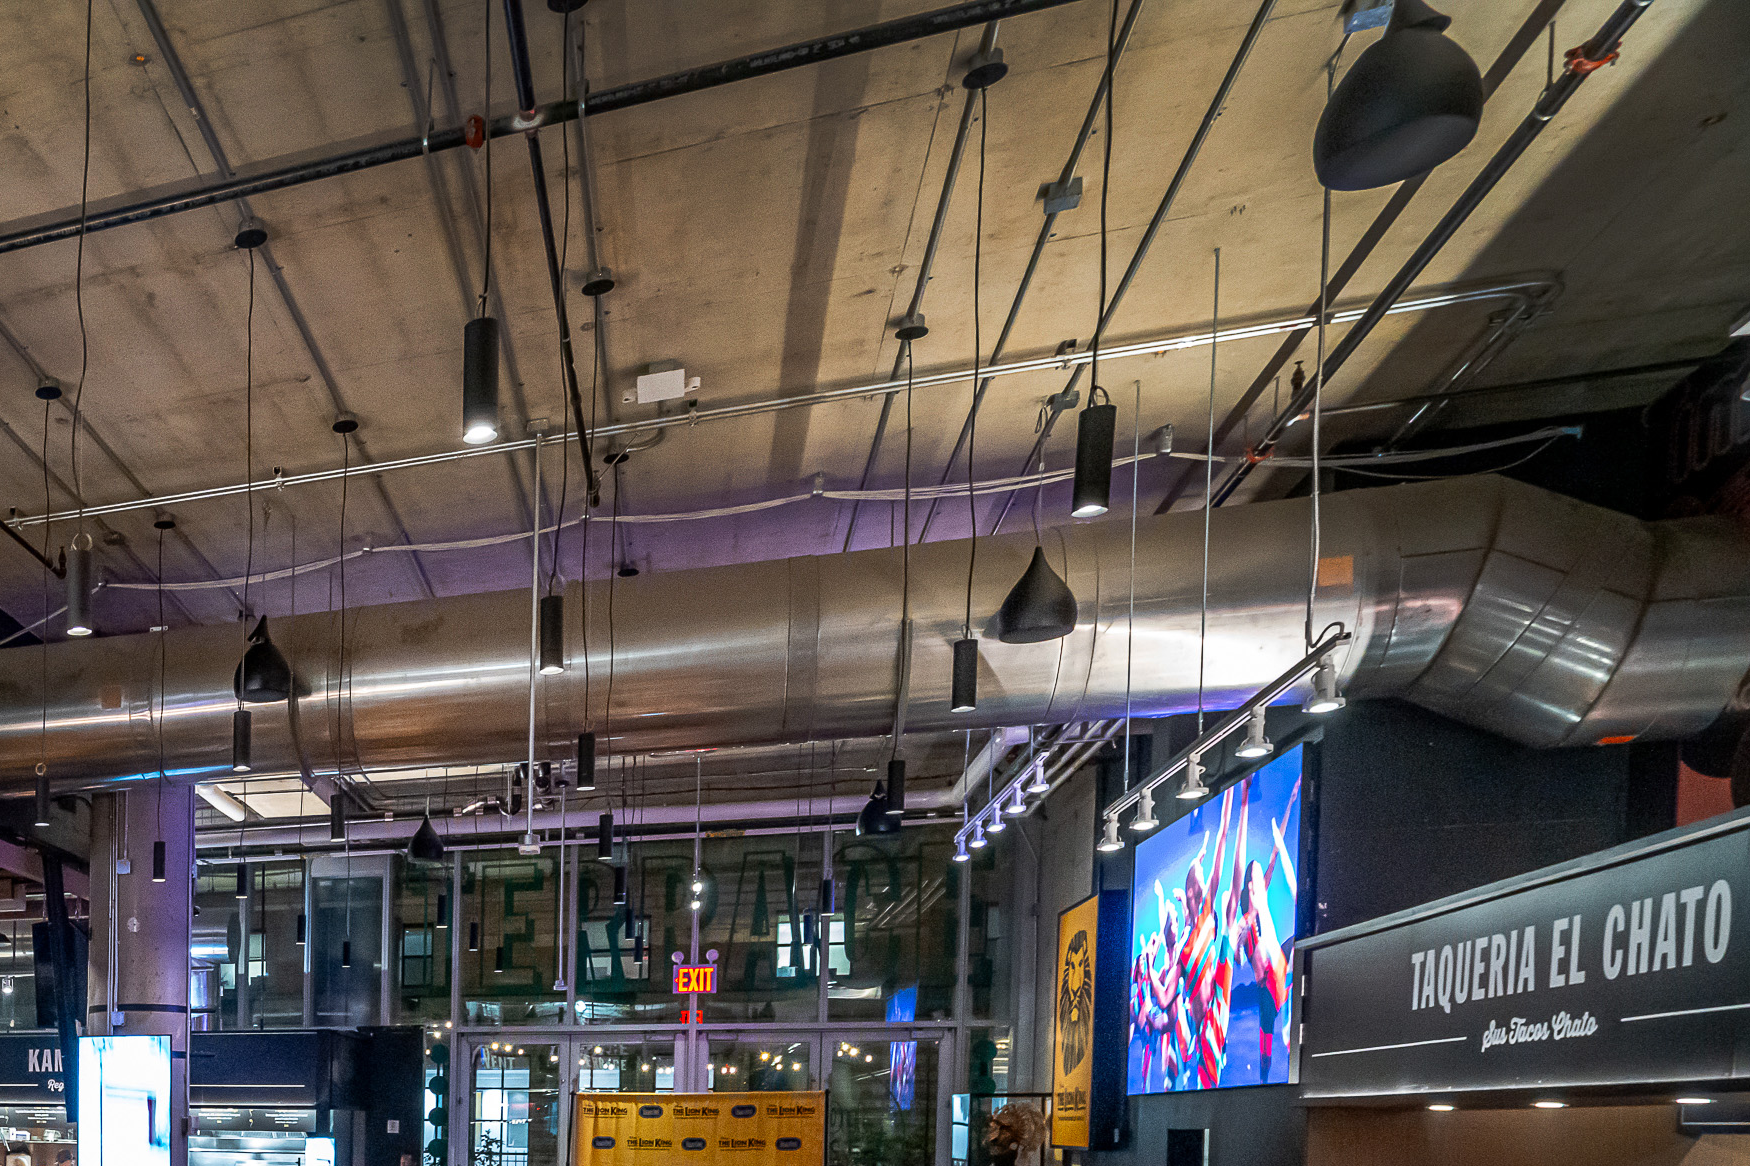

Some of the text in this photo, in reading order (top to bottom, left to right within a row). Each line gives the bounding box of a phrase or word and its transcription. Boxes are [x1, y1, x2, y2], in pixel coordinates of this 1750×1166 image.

[1411, 879, 1732, 1013] TAQUERIA EL CHATO
[678, 968, 714, 992] EXIT
[1481, 1010, 1598, 1053] Sus Tacos Chato
[595, 1106, 609, 1115] LION
[611, 1106, 627, 1115] KING
[685, 1107, 700, 1116] LION
[702, 1107, 719, 1116] KING
[639, 1138, 654, 1147] LION
[655, 1138, 672, 1147] KING
